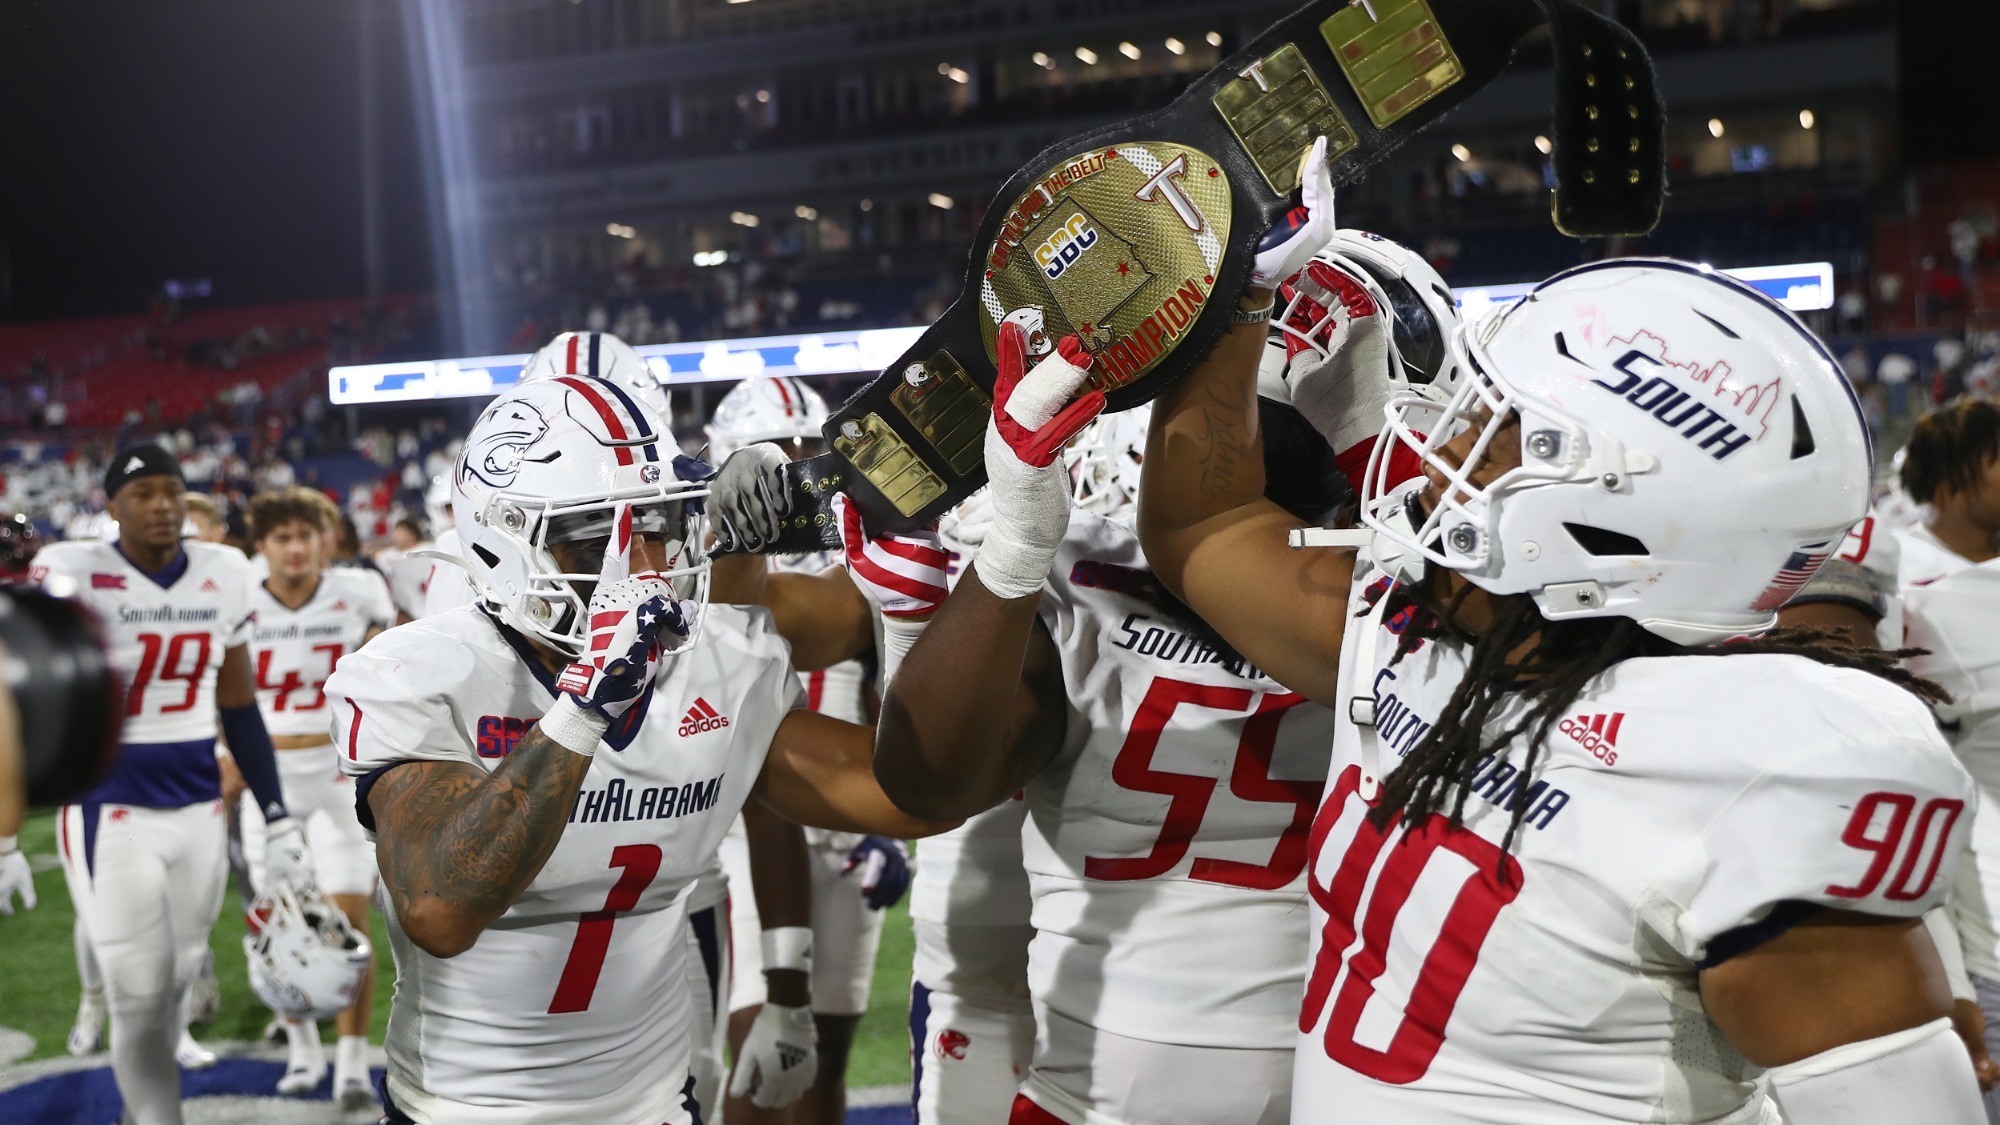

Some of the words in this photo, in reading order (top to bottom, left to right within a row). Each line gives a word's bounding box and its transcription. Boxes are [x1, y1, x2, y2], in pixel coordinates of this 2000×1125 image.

[1238, 57, 1269, 93] T
[1303, 96, 1322, 114] 2020
[1316, 115, 1335, 132] 2023
[991, 211, 1026, 269] BATTLE
[1018, 190, 1048, 219] FOR
[1042, 170, 1071, 196] THE
[1070, 154, 1105, 181] BELT
[1133, 152, 1203, 234] T
[1034, 212, 1098, 281] SBC
[1233, 310, 1261, 323] THEM
[1589, 349, 1752, 461] SOUTH
[123, 632, 211, 718] 19
[255, 643, 344, 713] 43
[344, 696, 364, 761] 1
[477, 715, 542, 759] SB
[678, 715, 730, 738] adidas
[1558, 718, 1619, 767] adidas
[568, 773, 725, 824] THALABAMA
[1084, 676, 1328, 890] 55
[1824, 791, 1965, 901] 90
[547, 843, 663, 1014] 1
[1299, 764, 1524, 1085] 90
